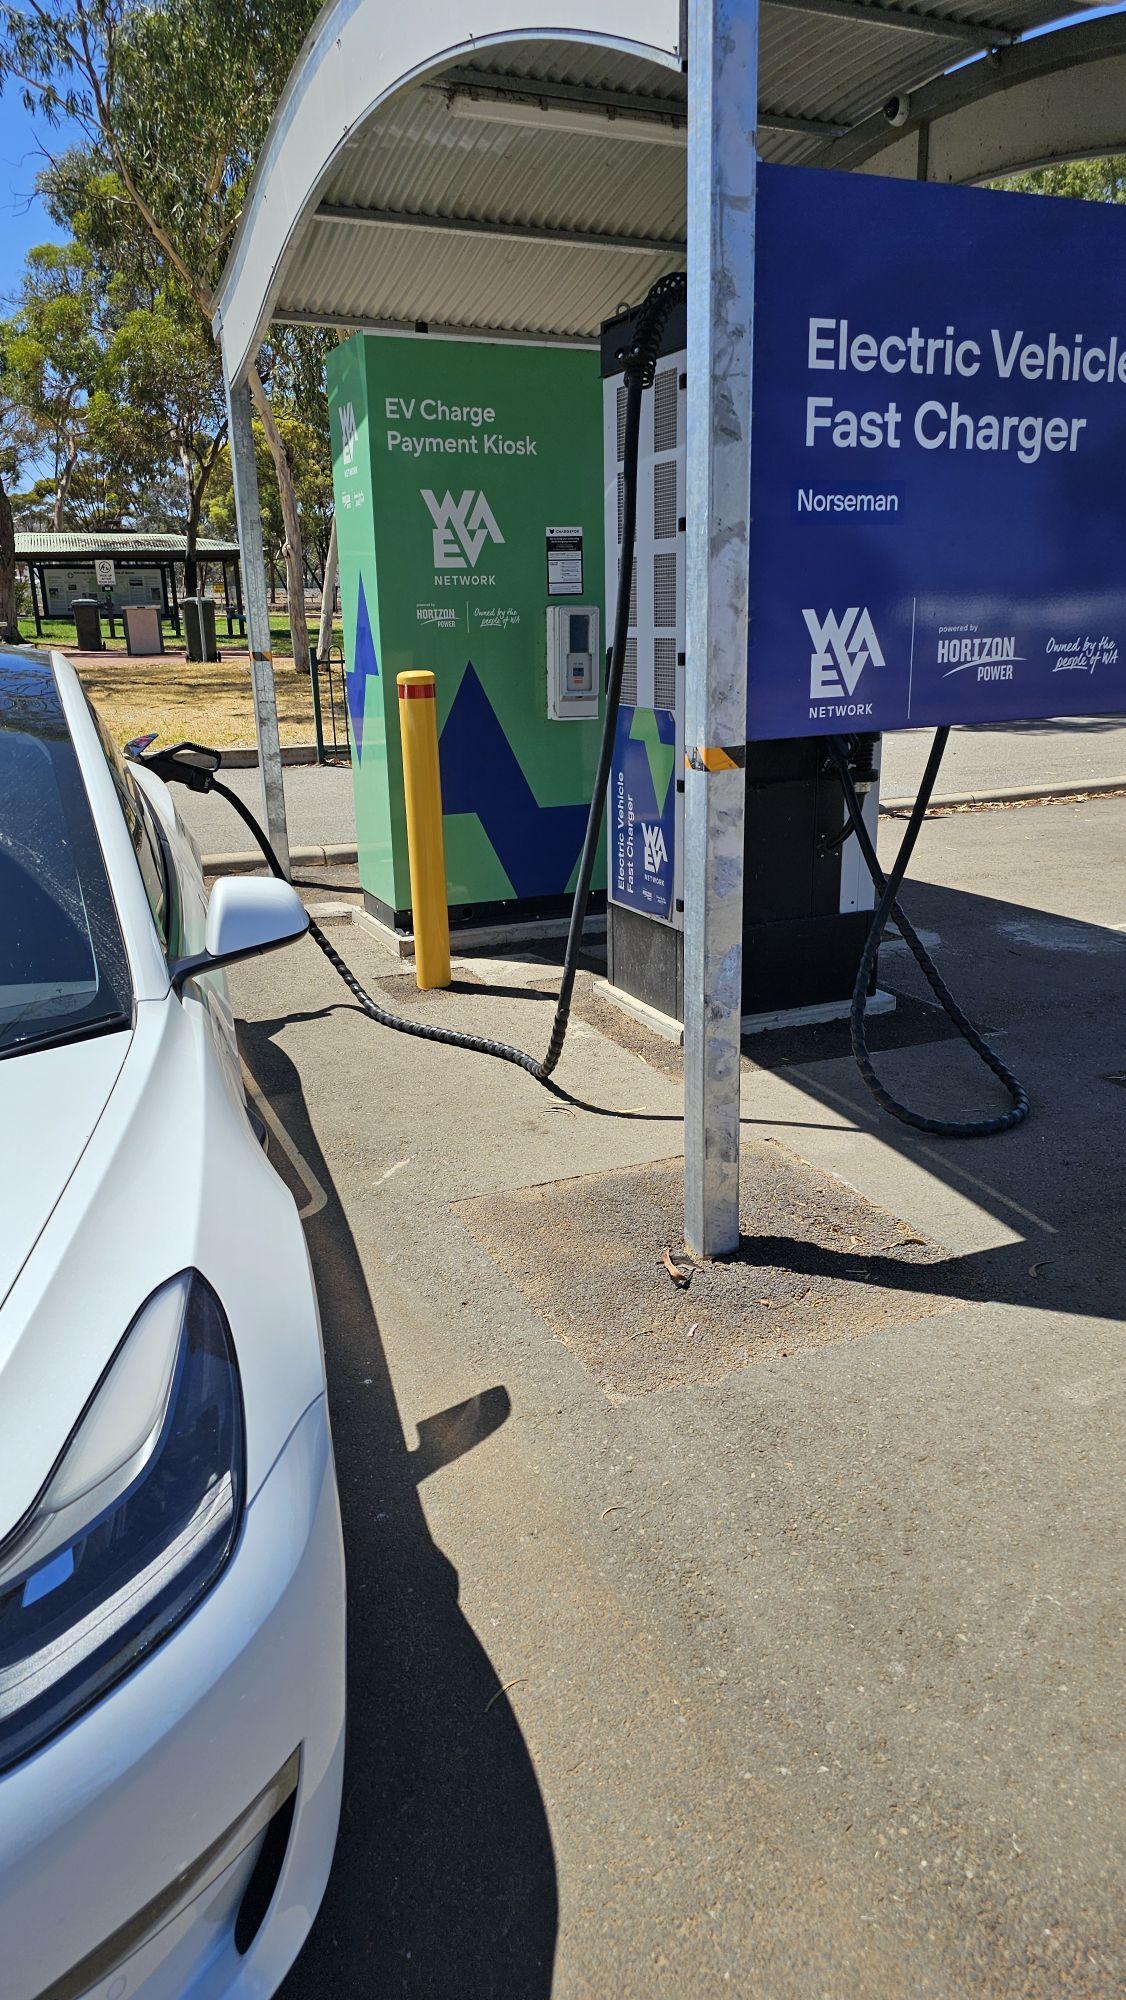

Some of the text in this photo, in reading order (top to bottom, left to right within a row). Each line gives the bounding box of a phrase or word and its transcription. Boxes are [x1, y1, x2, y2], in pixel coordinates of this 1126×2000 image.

[808, 317, 981, 377] Electric
[385, 398, 495, 427] EV Charge
[806, 396, 1087, 464] Fast Charger
[387, 431, 537, 457] Payment Kiosk
[797, 488, 898, 512] Norseman
[420, 489, 506, 543] WA
[432, 529, 487, 568] EV
[434, 575, 496, 586] NETWORK
[416, 608, 455, 619] HORIZON
[437, 620, 456, 628] POWER
[474, 607, 495, 616] Owned
[497, 608, 505, 619] by
[502, 616, 509, 629] of
[801, 607, 886, 667] WA
[938, 623, 979, 634] powered by
[937, 636, 1016, 663] HORIZON
[1046, 636, 1116, 657] Owned by the
[977, 665, 1013, 681] POWER
[1052, 649, 1119, 674] people of WA
[809, 652, 869, 699] EV
[809, 703, 873, 719] NETWORK
[627, 794, 635, 858] Charger
[617, 832, 625, 890] Electric
